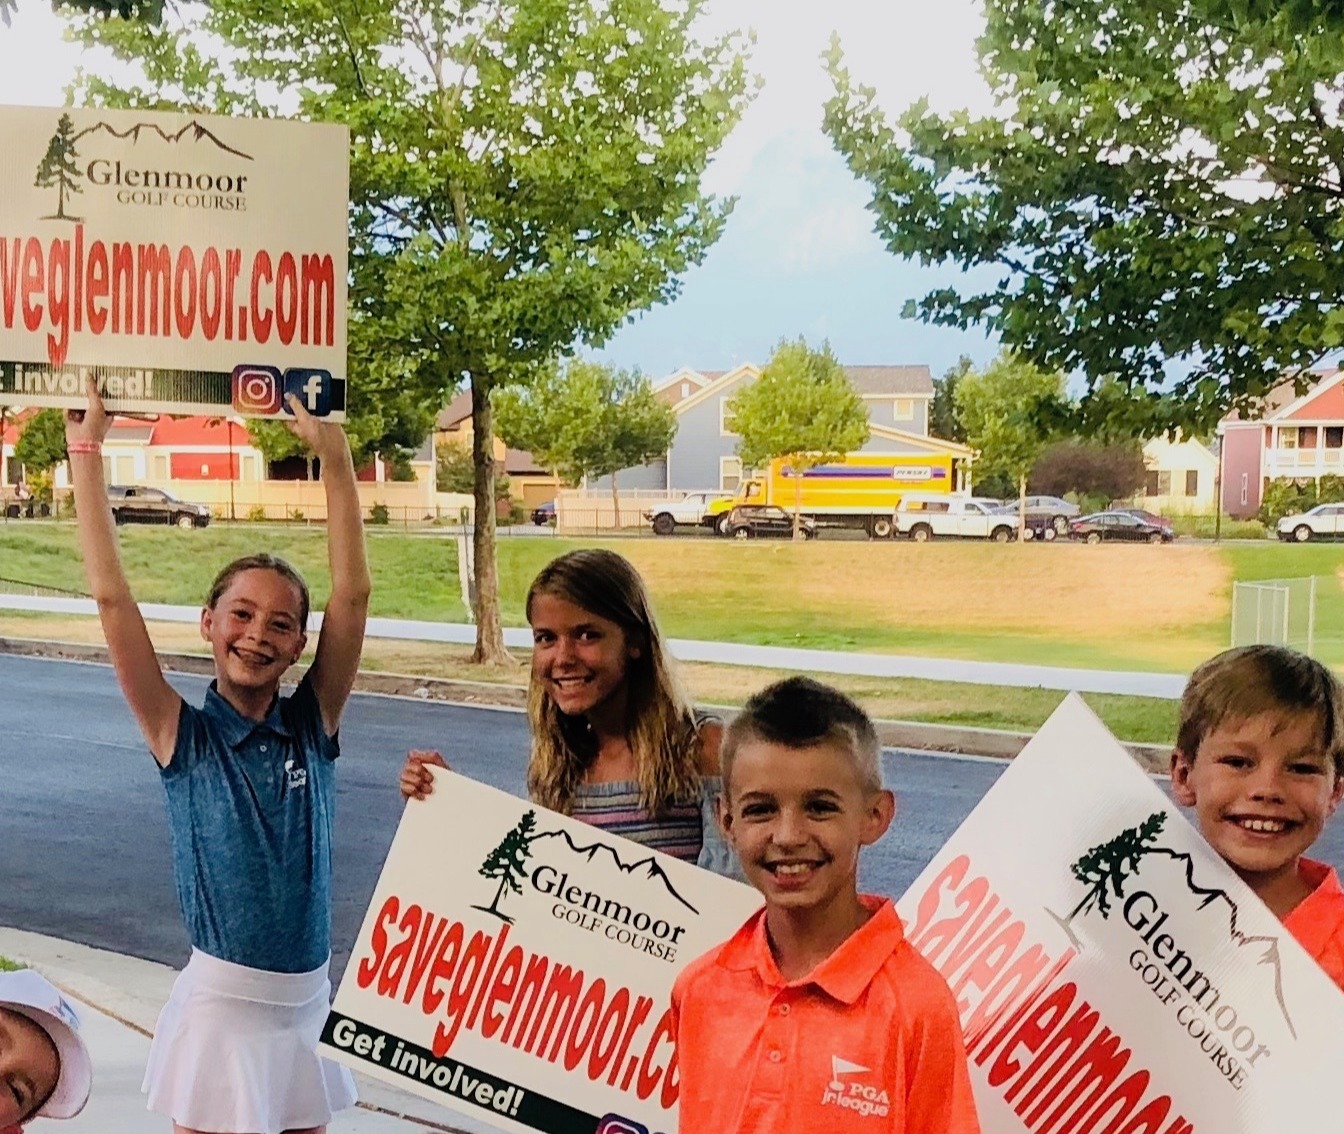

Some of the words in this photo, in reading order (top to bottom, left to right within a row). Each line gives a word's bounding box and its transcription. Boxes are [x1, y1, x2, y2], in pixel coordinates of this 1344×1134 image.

[86, 159, 248, 193] Glenmoor
[117, 190, 169, 206] GOLF
[173, 193, 247, 211] COURSE
[531, 865, 686, 945] Glenmoor
[552, 904, 601, 933] GOLF
[605, 924, 677, 963] COURSE
[357, 896, 680, 1109] saveglenmoor.c
[1123, 891, 1271, 1068] Glenmoor
[1129, 949, 1182, 1006] GOLF
[1176, 1004, 1249, 1090] COURSE
[332, 1020, 385, 1060] Get
[390, 1042, 525, 1116] involved!
[849, 1082, 890, 1104] PGA
